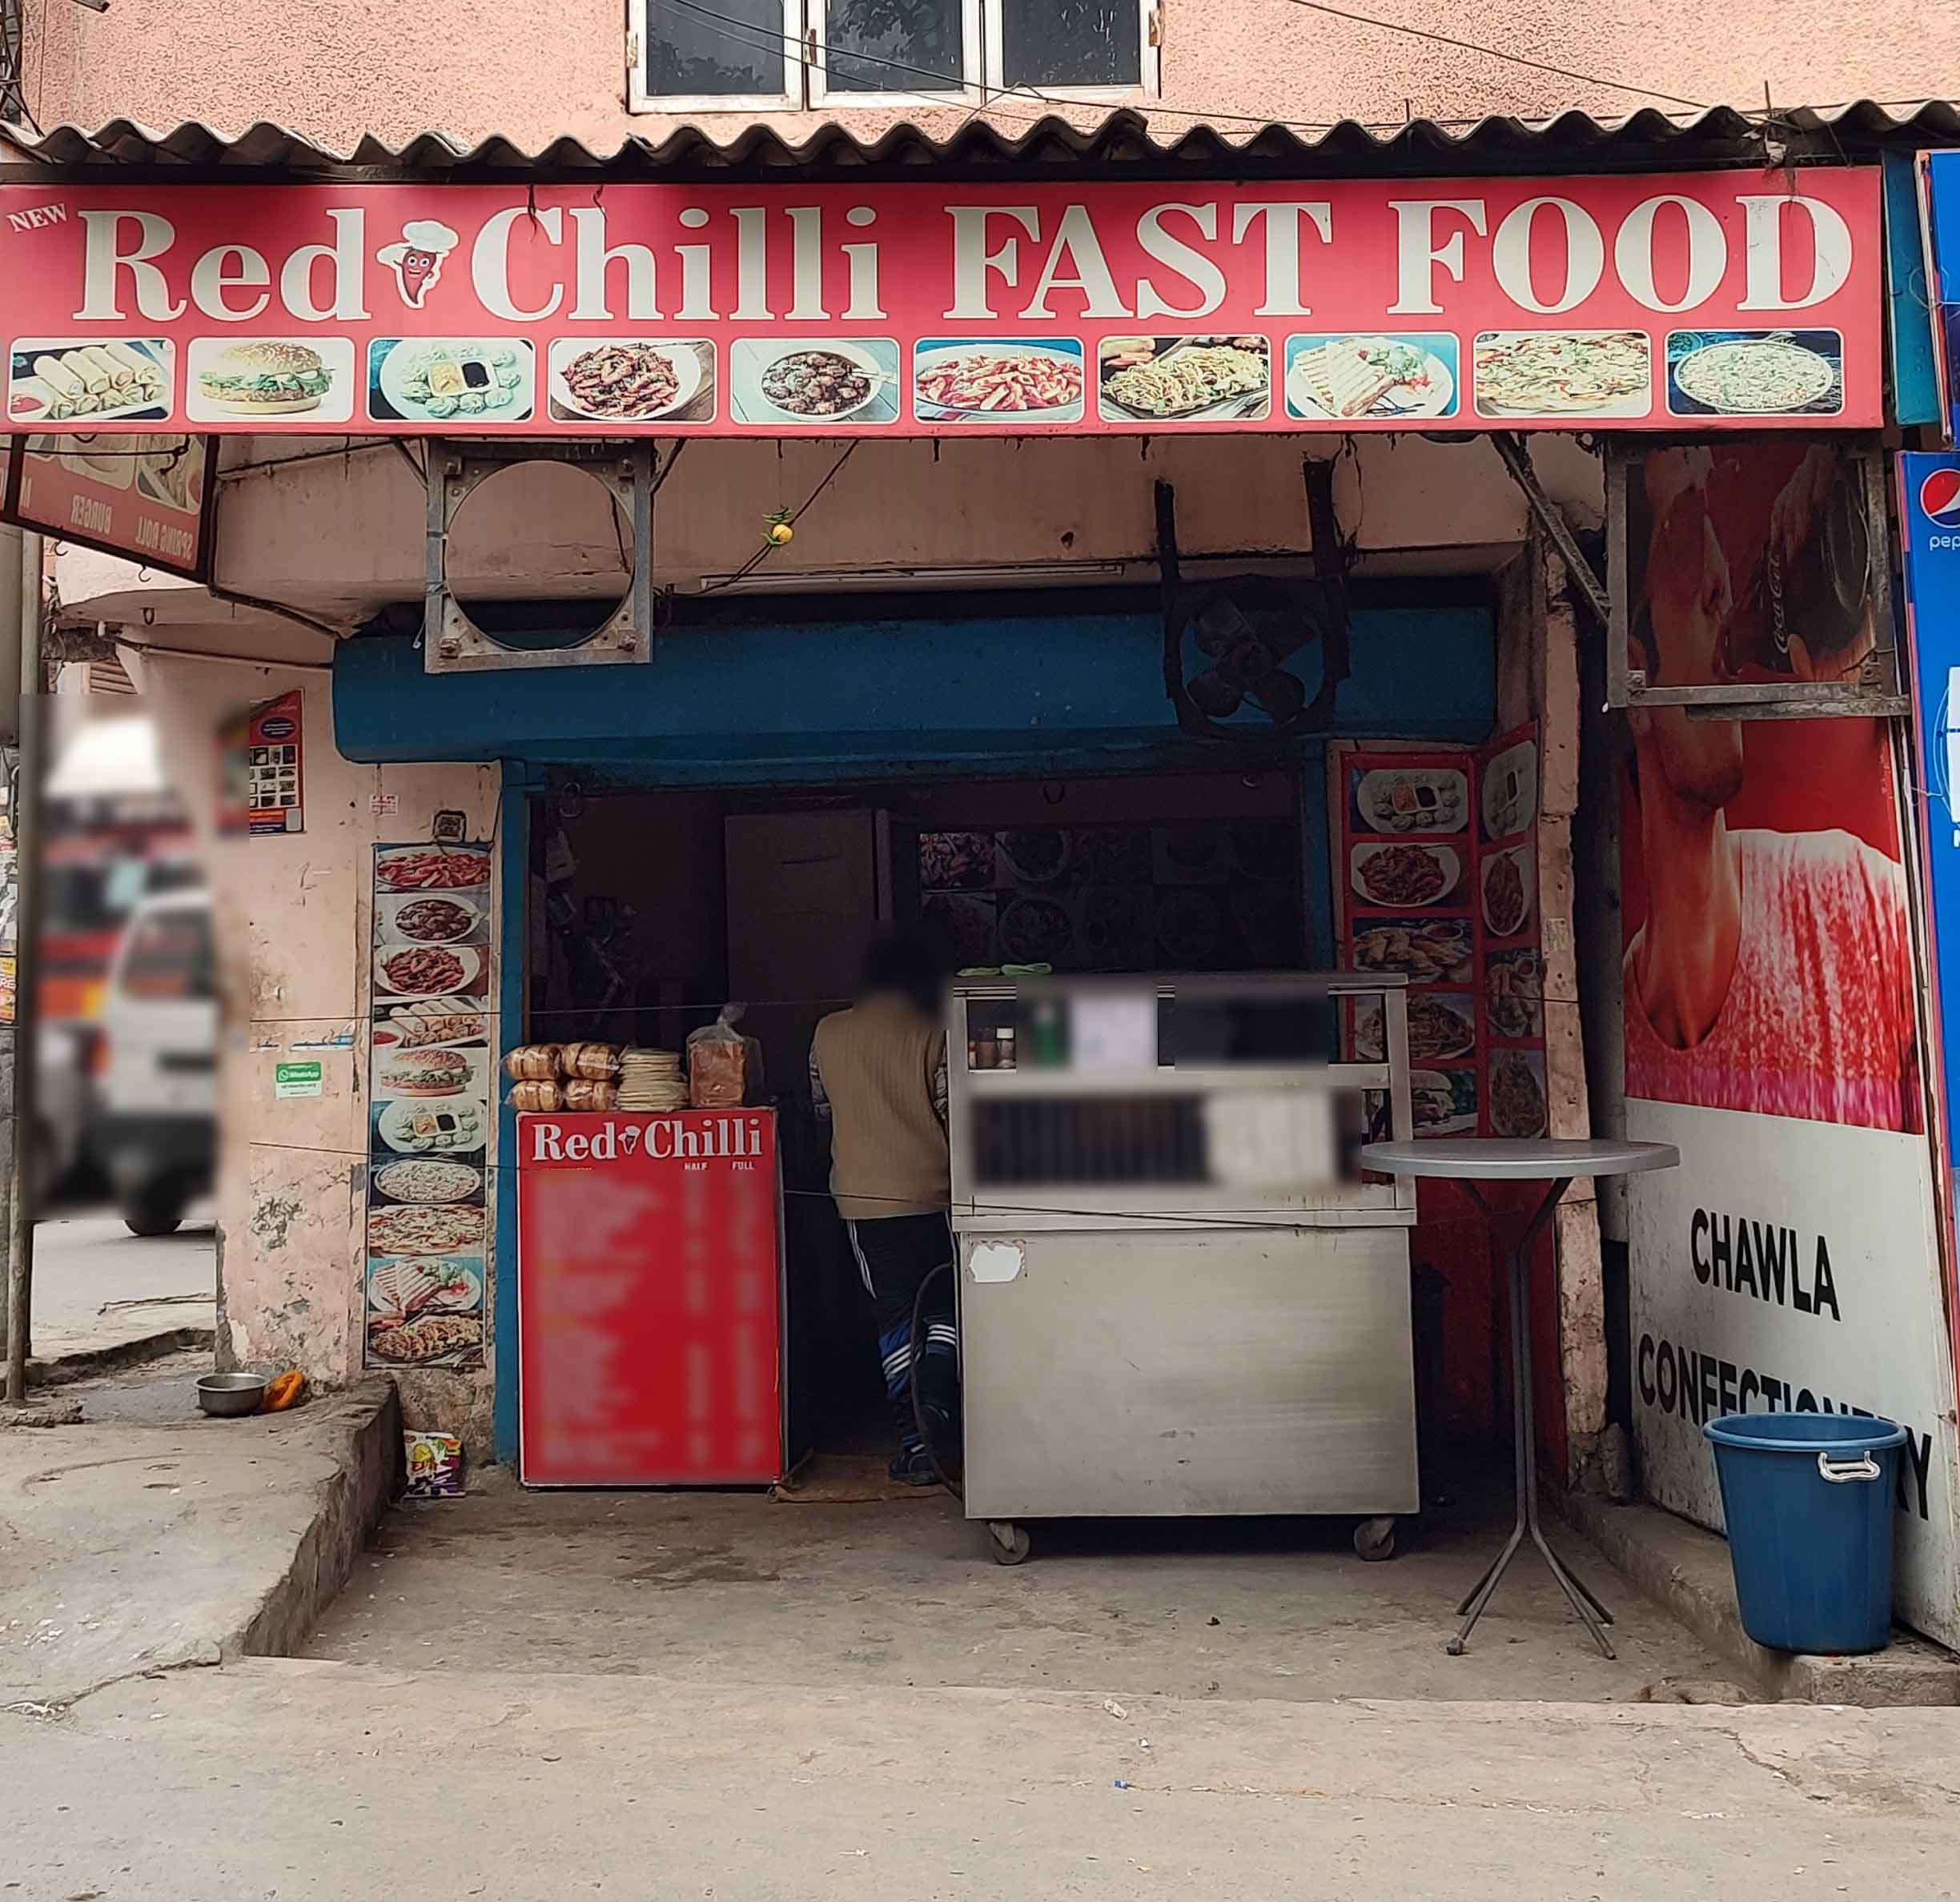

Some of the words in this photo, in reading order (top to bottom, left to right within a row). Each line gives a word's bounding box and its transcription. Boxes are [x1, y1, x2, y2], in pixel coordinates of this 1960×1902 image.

[6, 203, 67, 232] NEW
[72, 208, 372, 321] Red
[472, 206, 889, 321] Chilli
[942, 202, 1332, 319] FAST
[1386, 195, 1853, 315] FOOD
[532, 1122, 617, 1161] Red
[645, 1118, 762, 1158] Chilli
[685, 1162, 708, 1170] HALF
[732, 1161, 755, 1170] FULL
[1692, 1207, 1841, 1322] CHAWLA
